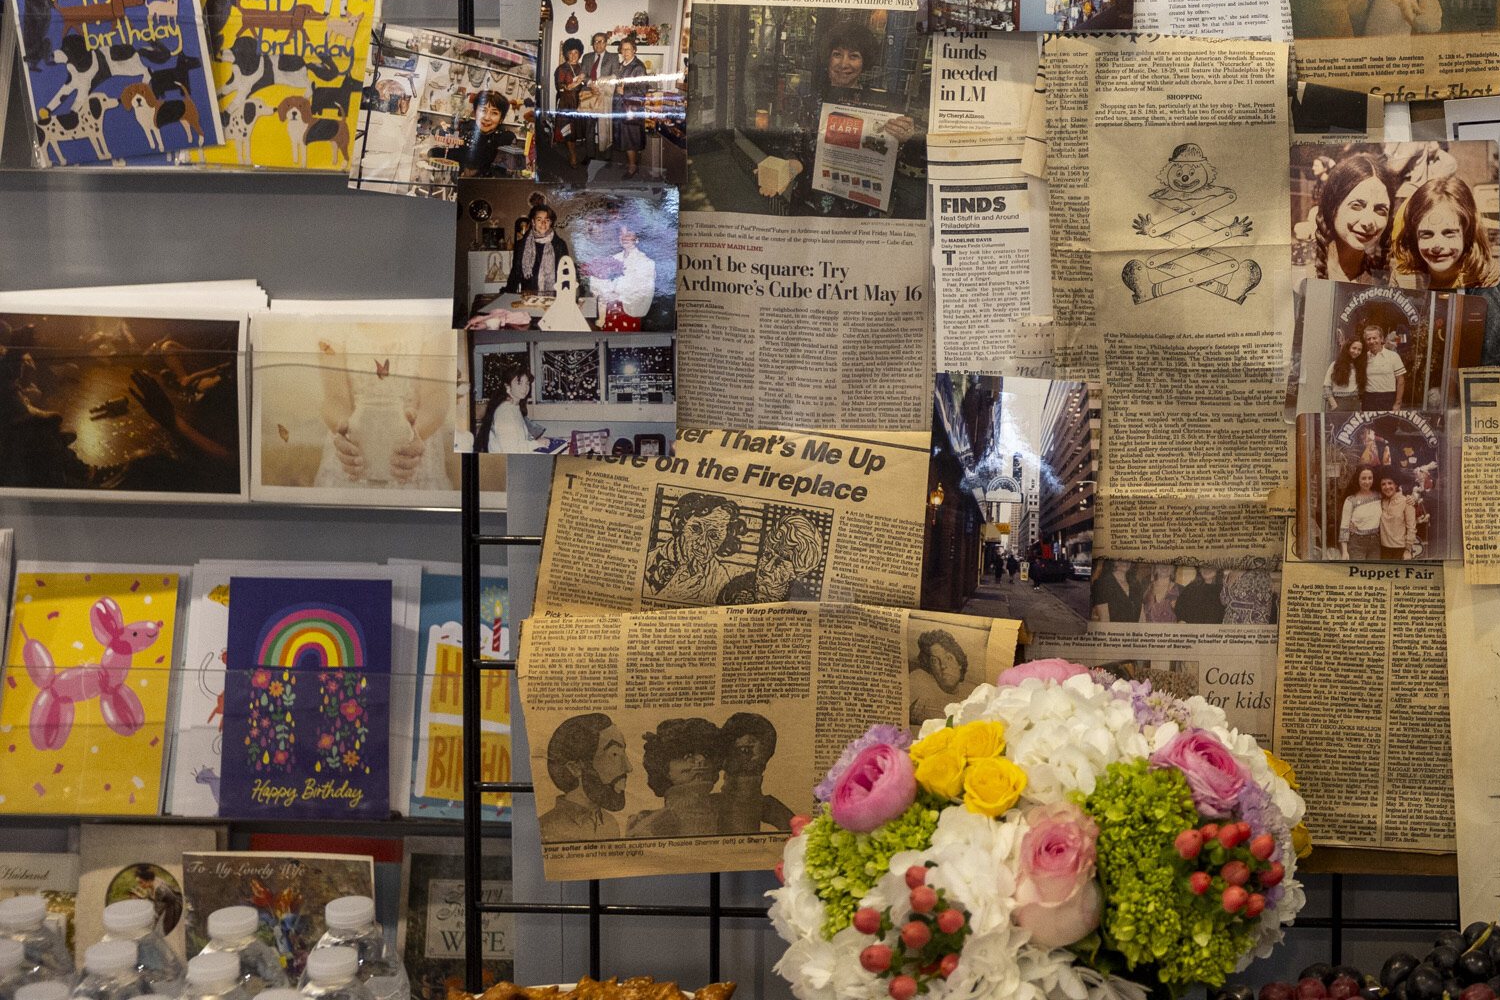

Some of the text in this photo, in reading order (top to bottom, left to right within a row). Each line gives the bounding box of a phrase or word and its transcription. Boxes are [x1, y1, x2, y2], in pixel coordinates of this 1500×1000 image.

[83, 19, 182, 56] birthday
[256, 29, 354, 77] birthday
[943, 43, 986, 59] funds
[942, 65, 997, 81] needed
[941, 85, 985, 101] in LM
[941, 196, 1006, 213] FINDS
[678, 254, 850, 283] Don't be square: Try
[678, 276, 922, 306] Ardmore's Cube d'Art May 16
[1464, 436, 1497, 444] Shooting
[720, 428, 886, 475] That's Me Up
[652, 450, 867, 502] on the Fireplace
[1349, 566, 1434, 580] Puppet Fair
[1206, 668, 1254, 685] Coats
[1204, 690, 1272, 709] for kids
[252, 778, 363, 808] Happy Birthday
